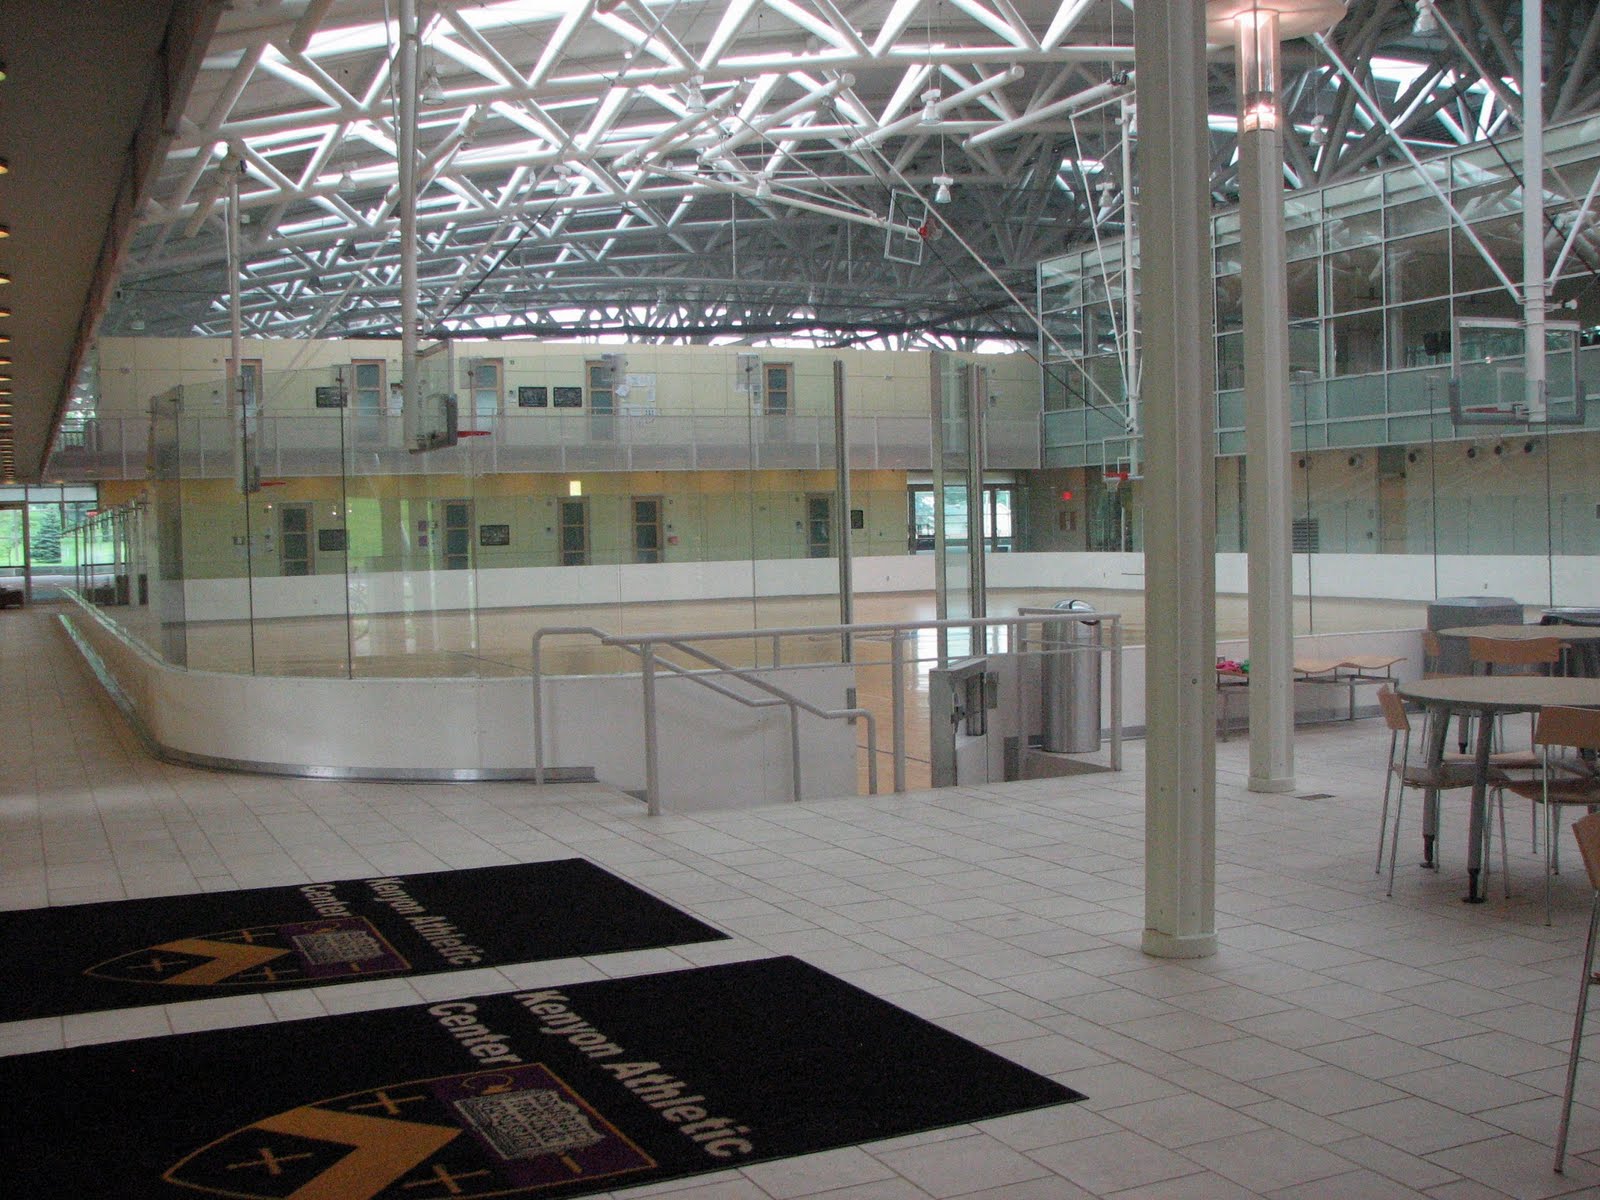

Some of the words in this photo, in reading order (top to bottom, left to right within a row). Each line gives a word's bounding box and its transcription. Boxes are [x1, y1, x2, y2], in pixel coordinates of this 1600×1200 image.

[300, 884, 353, 918] Center
[364, 877, 428, 915] Kenyon
[405, 916, 485, 965] Athletic
[427, 1002, 522, 1064] Center
[513, 989, 625, 1059] Kenyon
[600, 1061, 753, 1158] Athletic
